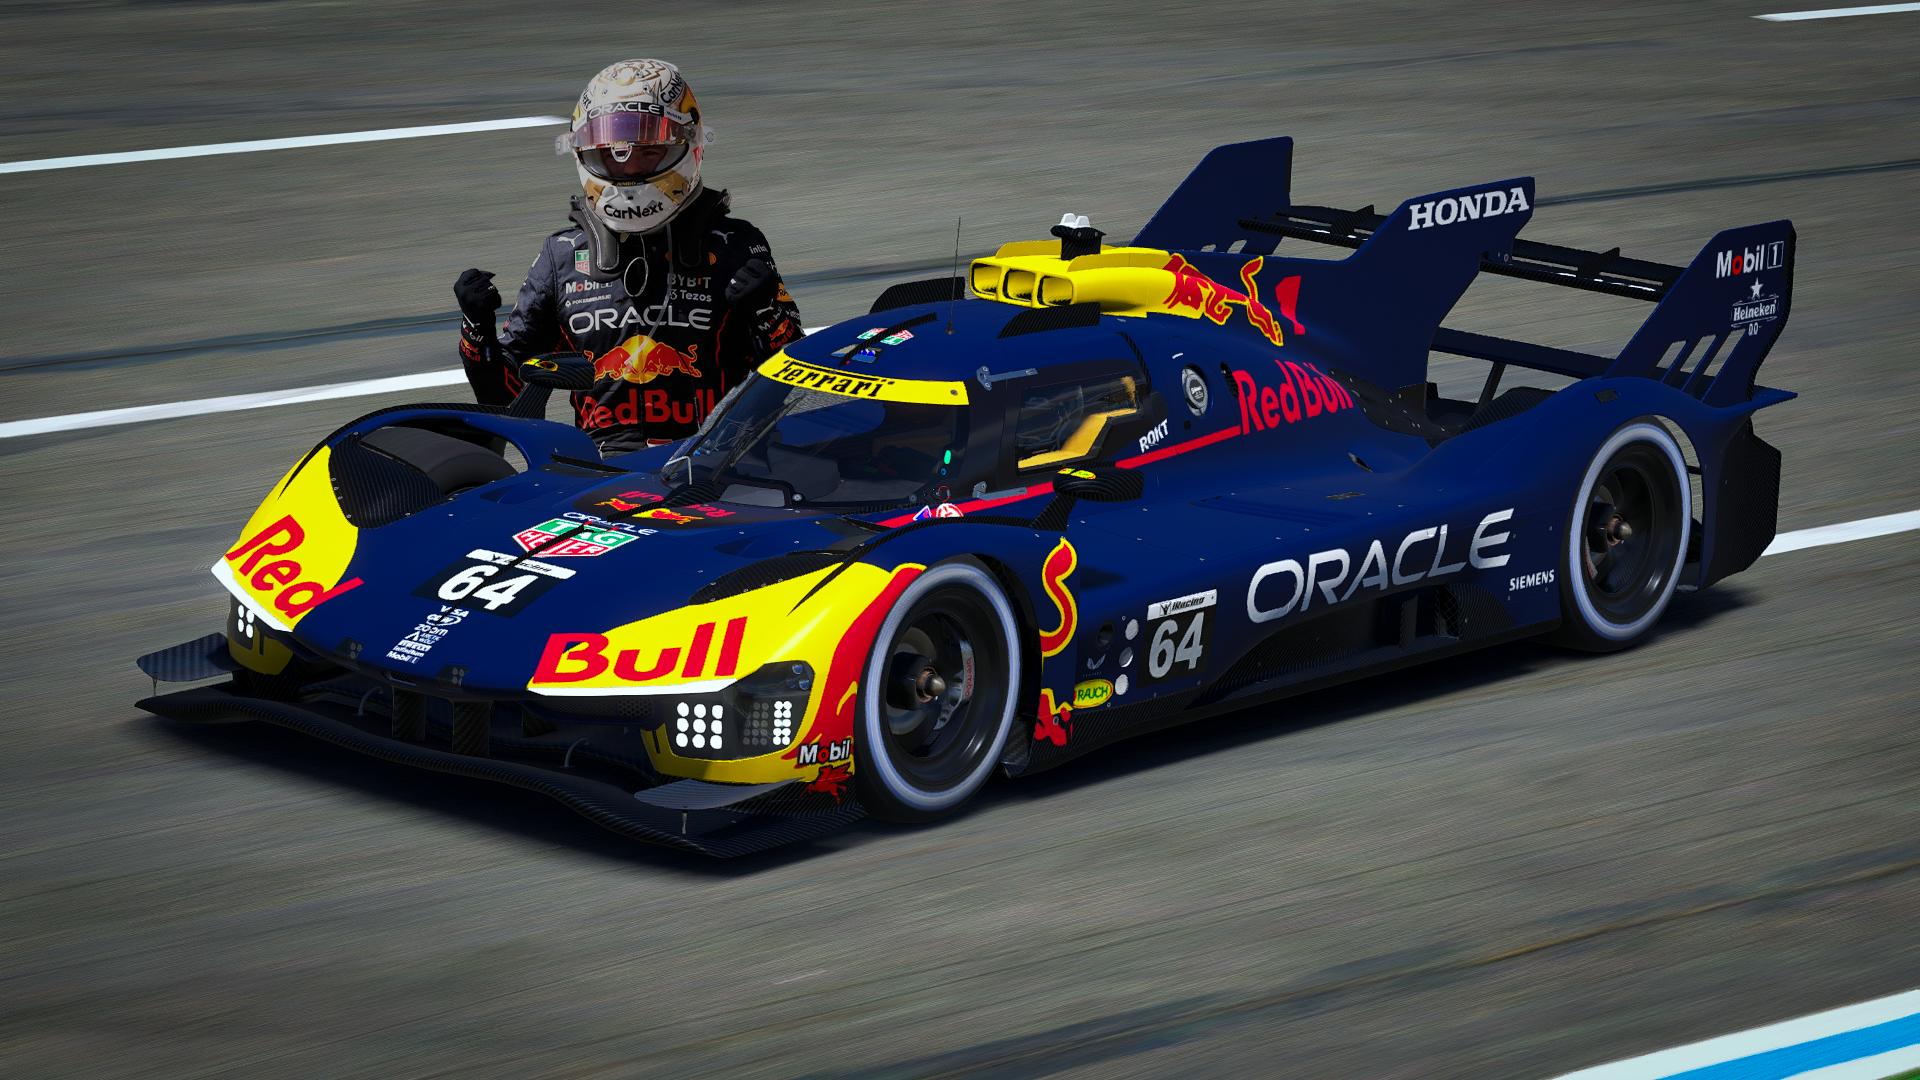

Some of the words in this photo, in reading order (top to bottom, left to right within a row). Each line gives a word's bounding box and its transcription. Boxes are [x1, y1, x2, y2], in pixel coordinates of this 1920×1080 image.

[588, 102, 661, 118] ORACLE
[603, 201, 664, 219] CarNext
[1408, 187, 1529, 230] HONDA
[1716, 244, 1765, 279] Mobil
[565, 280, 600, 294] Mobil
[667, 272, 712, 289] BYBIT
[680, 290, 712, 302] Tezos
[1733, 301, 1777, 321] Heineken
[569, 305, 713, 335] ORACLE
[772, 360, 888, 397] Ferrari
[578, 388, 638, 430] Red
[644, 388, 715, 424] Bull
[1232, 359, 1302, 435] Red
[1284, 361, 1354, 418] Bull
[1139, 419, 1169, 453] ROKT
[549, 520, 625, 546] TAG
[225, 514, 365, 619] Red
[1247, 508, 1514, 623] ORACLE
[1509, 569, 1555, 591] SIEMENS
[438, 564, 539, 611] 64
[440, 605, 470, 618] VSA
[532, 616, 748, 684] Bull
[1149, 612, 1205, 679] 64
[1077, 685, 1109, 701] RAUCH
[799, 740, 850, 763] Mobil
